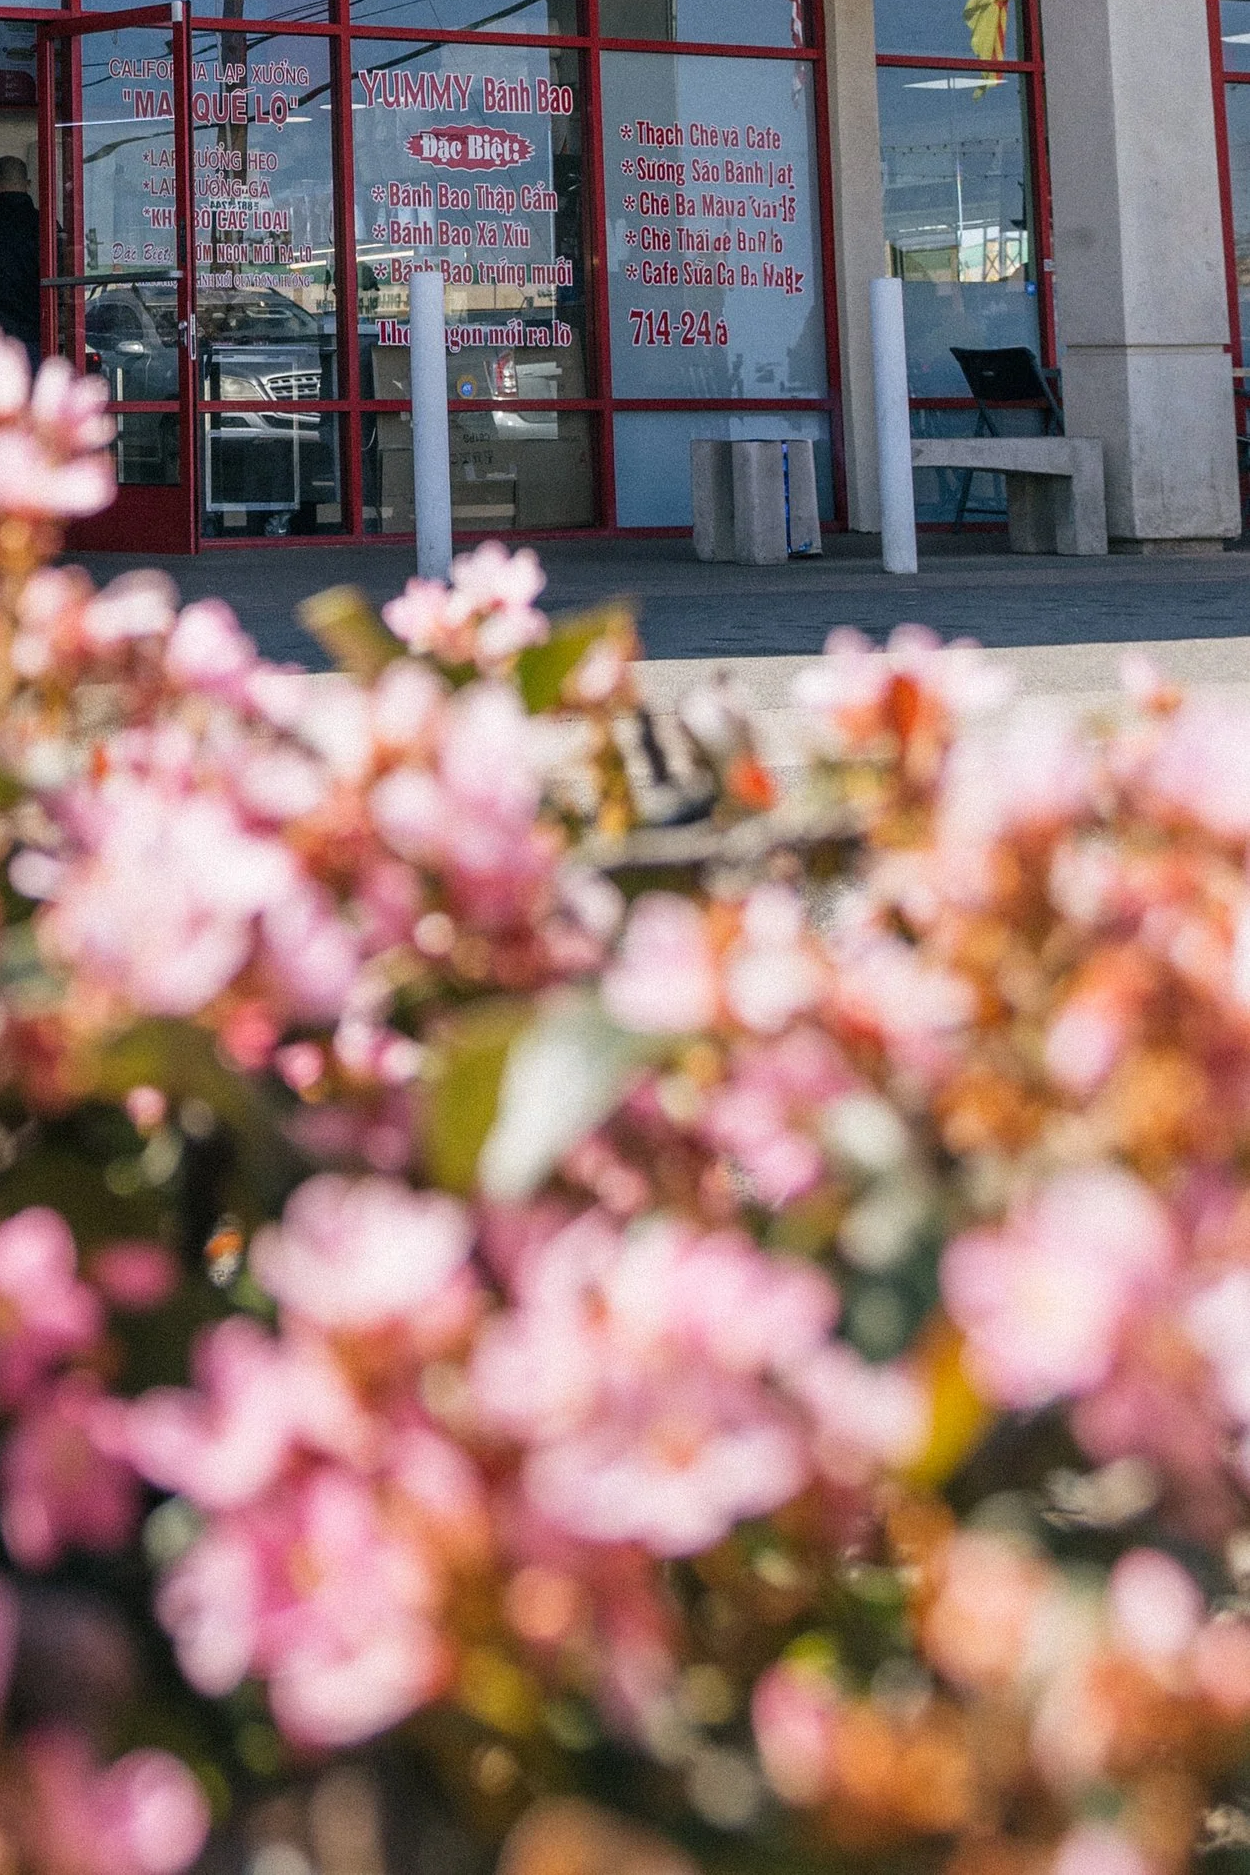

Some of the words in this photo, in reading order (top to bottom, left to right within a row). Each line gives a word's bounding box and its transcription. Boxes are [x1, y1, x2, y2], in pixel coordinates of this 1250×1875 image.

[109, 58, 208, 81] CALIFOIA
[358, 70, 474, 111] YUMMY
[483, 76, 532, 114] Bánh
[536, 77, 573, 115] Bao
[636, 120, 684, 150] Thạch
[689, 122, 719, 148] Chè
[721, 126, 739, 149] và
[746, 124, 781, 150] Cafe
[248, 152, 278, 171] HEO
[691, 158, 720, 184] Sáo
[724, 159, 764, 185] Bánh
[389, 181, 433, 209] Bánh
[437, 182, 470, 211] Bao
[475, 184, 516, 215] Thập
[639, 191, 670, 217] Chè
[675, 192, 696, 218] Ba
[390, 220, 433, 246] Bánh
[437, 221, 471, 247] Bao
[476, 220, 498, 248] Xá
[502, 221, 531, 248] Xíu
[640, 226, 671, 252] Chè
[217, 243, 248, 264] NGON
[279, 244, 295, 264] RA
[440, 258, 473, 285] Bao
[642, 260, 679, 286] Cafe
[526, 326, 550, 347] ra
[553, 320, 573, 347] lò
